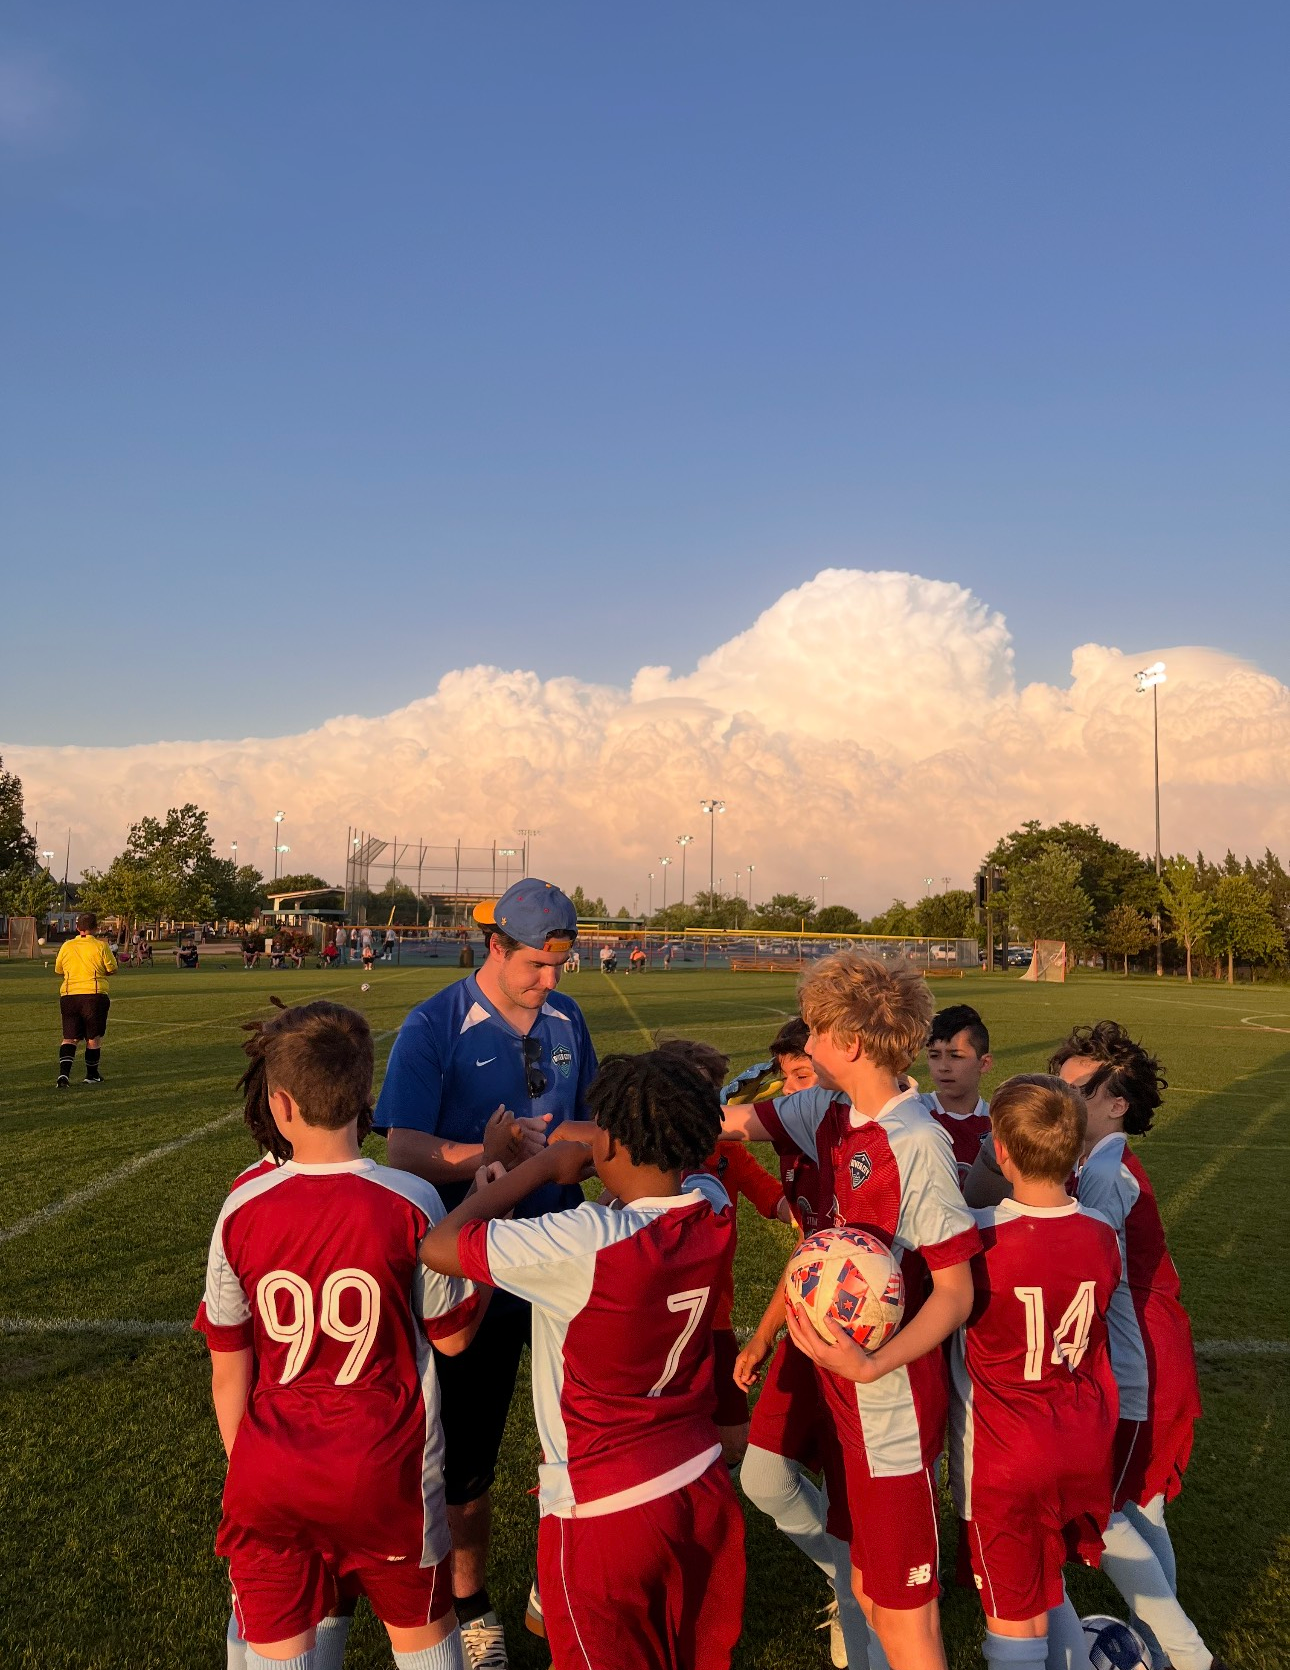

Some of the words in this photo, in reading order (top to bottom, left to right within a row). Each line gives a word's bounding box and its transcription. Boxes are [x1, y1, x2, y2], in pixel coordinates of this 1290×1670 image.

[257, 1268, 381, 1386] 99
[646, 1286, 711, 1397] 7
[1014, 1281, 1097, 1381] 14
